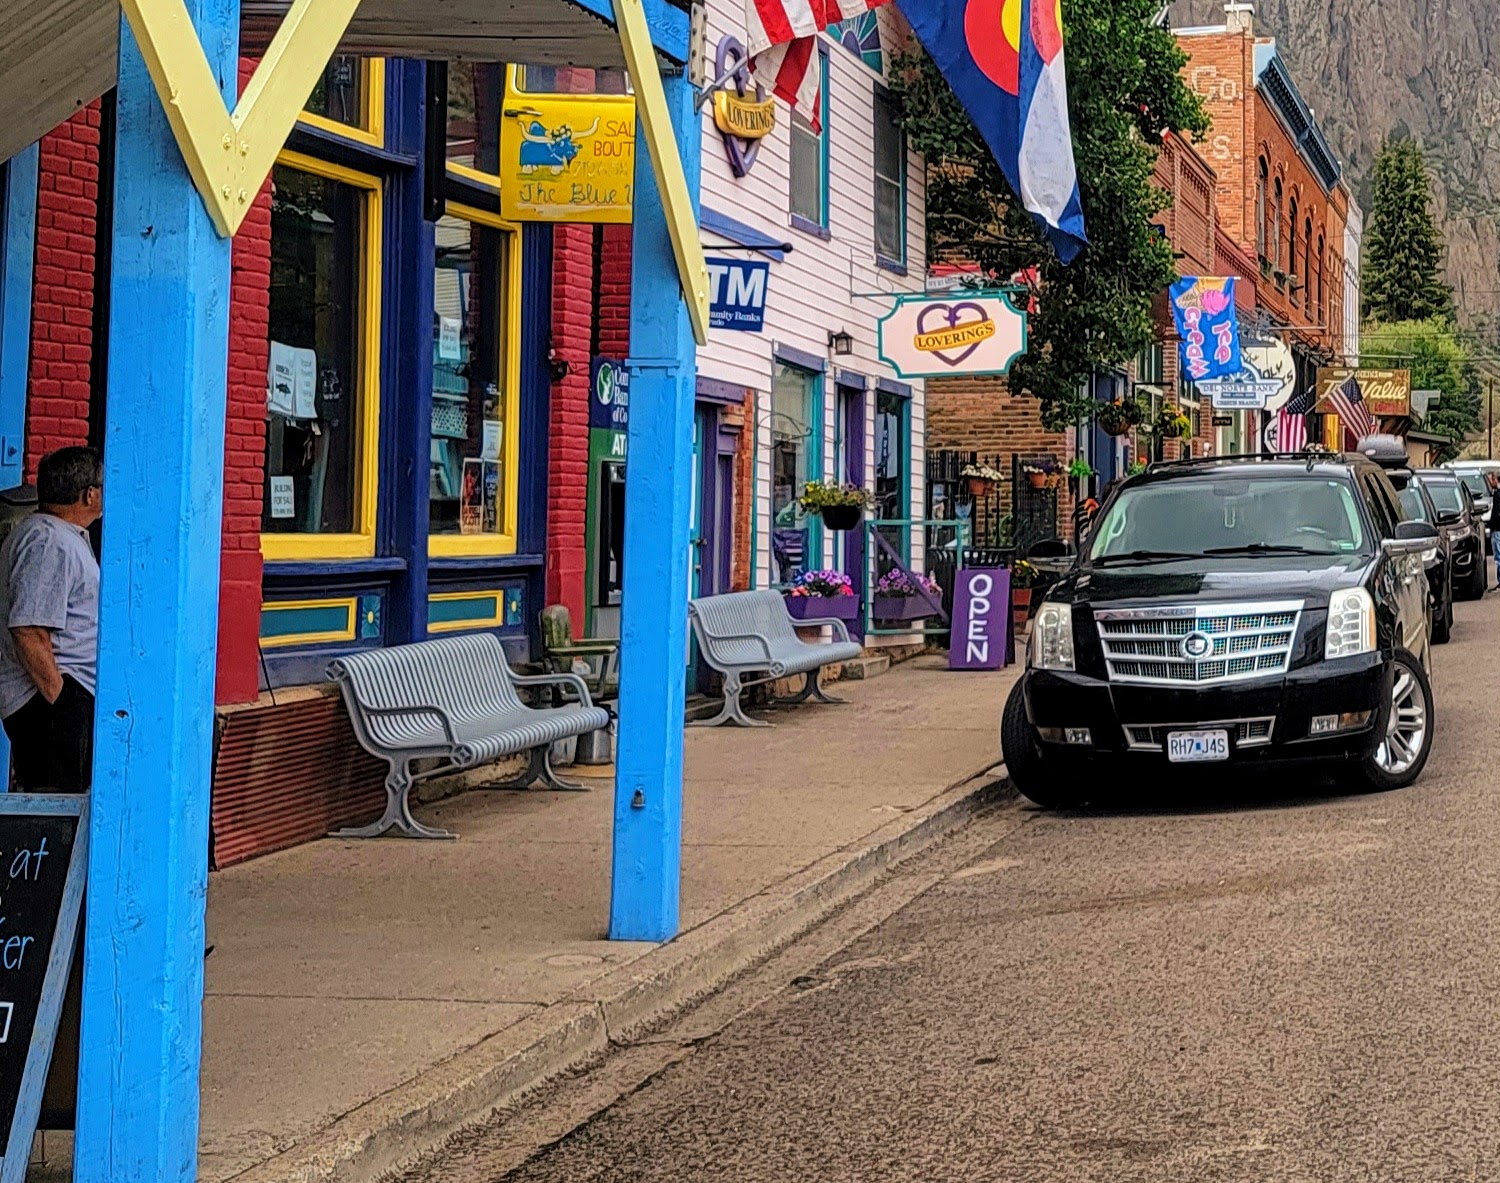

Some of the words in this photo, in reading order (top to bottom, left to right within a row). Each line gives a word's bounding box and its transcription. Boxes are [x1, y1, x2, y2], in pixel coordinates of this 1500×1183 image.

[727, 102, 775, 131] LOVERING'S
[520, 183, 556, 203] The
[569, 182, 617, 204] Blue
[706, 264, 766, 308] TM
[1203, 384, 1219, 392] DEL
[1221, 384, 1248, 392] NORTE
[1251, 384, 1274, 392] BANK
[1358, 380, 1407, 400] Value
[966, 573, 993, 664] OPEN
[1170, 738, 1194, 755] RH7
[9, 836, 50, 881] at
[0, 934, 35, 970] er
